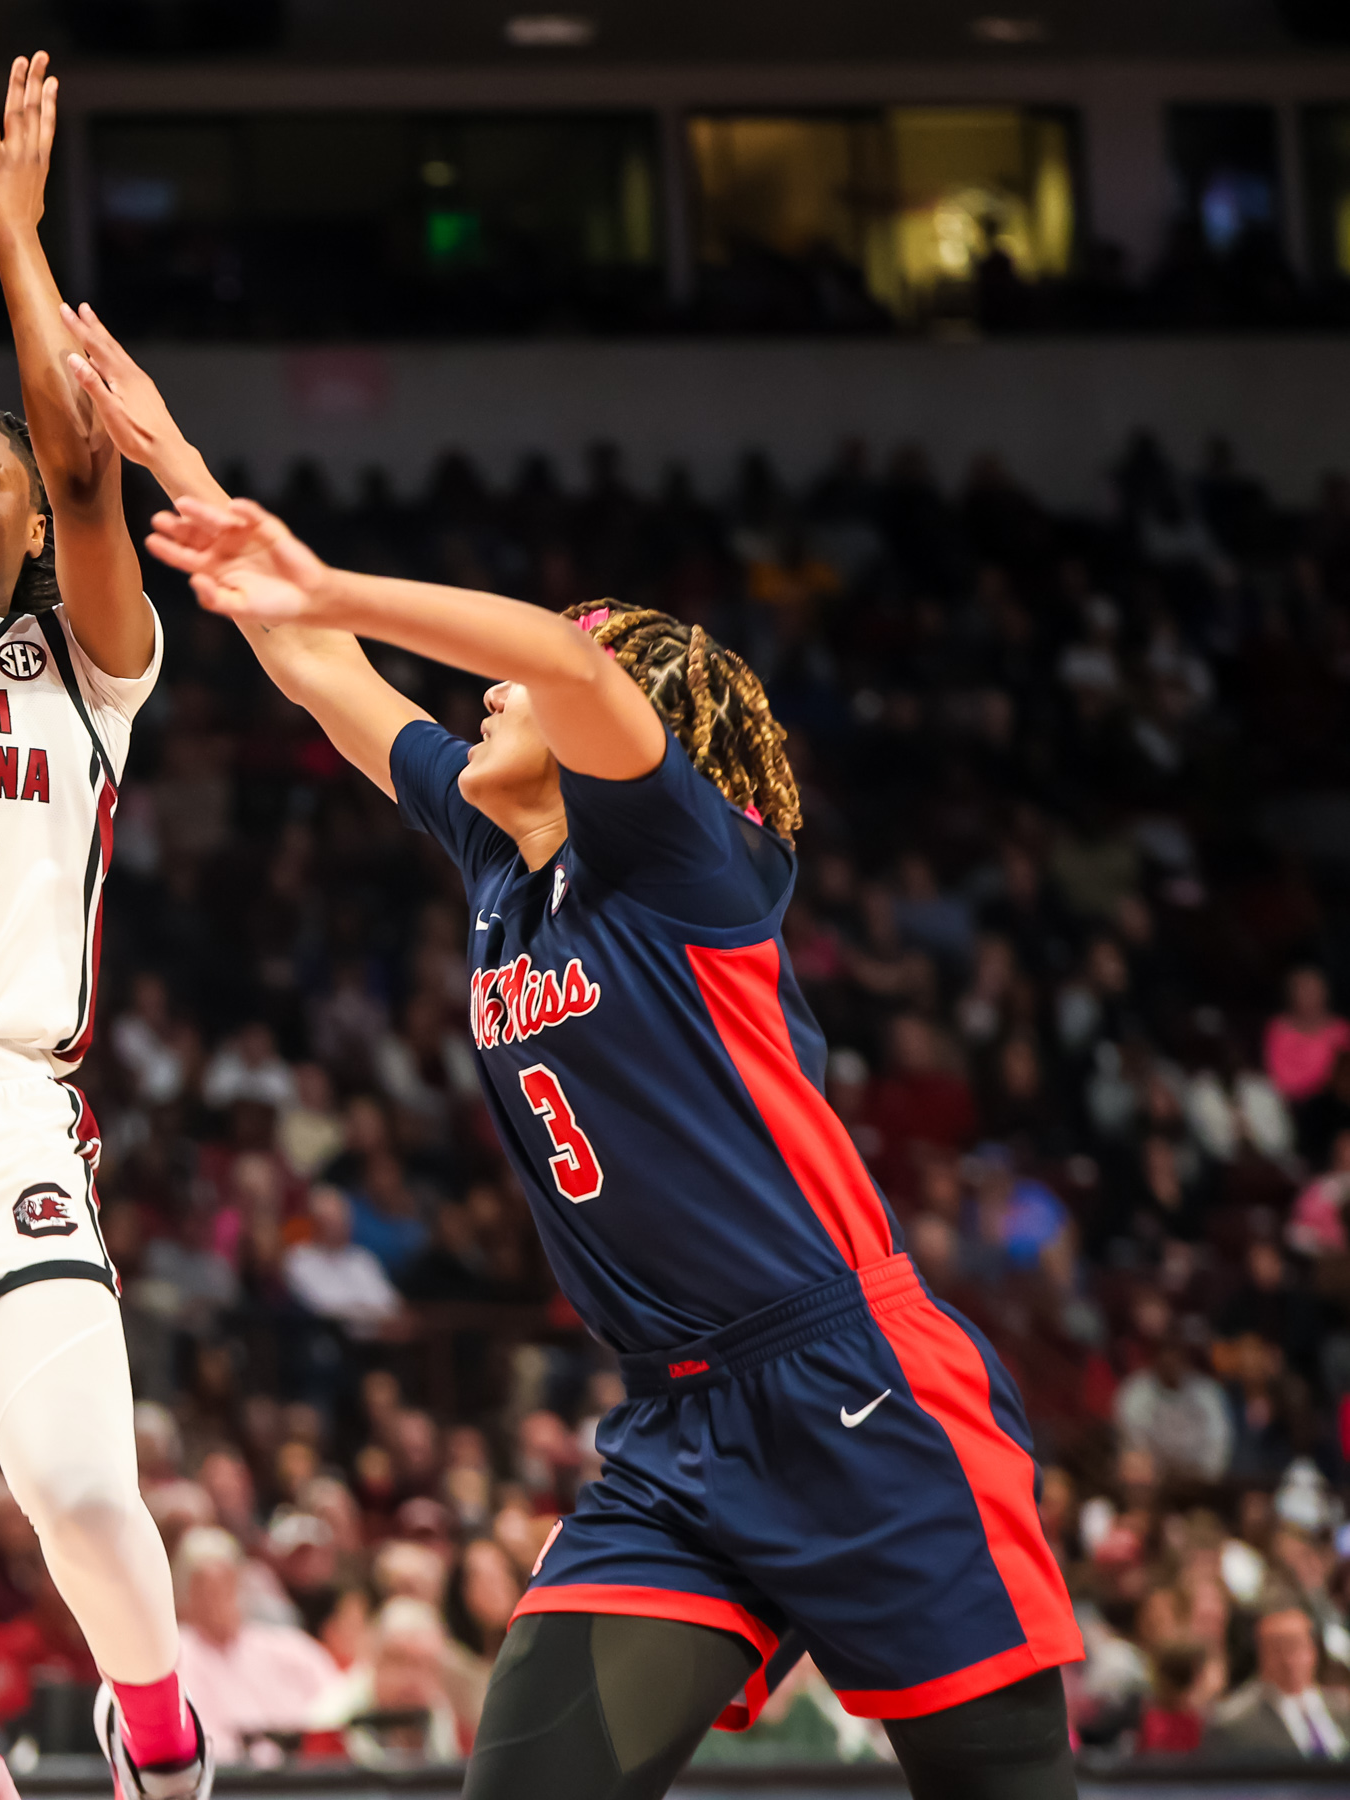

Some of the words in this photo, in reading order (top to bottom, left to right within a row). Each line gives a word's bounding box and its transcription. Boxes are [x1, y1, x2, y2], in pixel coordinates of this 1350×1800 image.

[0, 643, 43, 677] SEC
[496, 953, 601, 1043] Miss
[518, 1063, 604, 1204] 3
